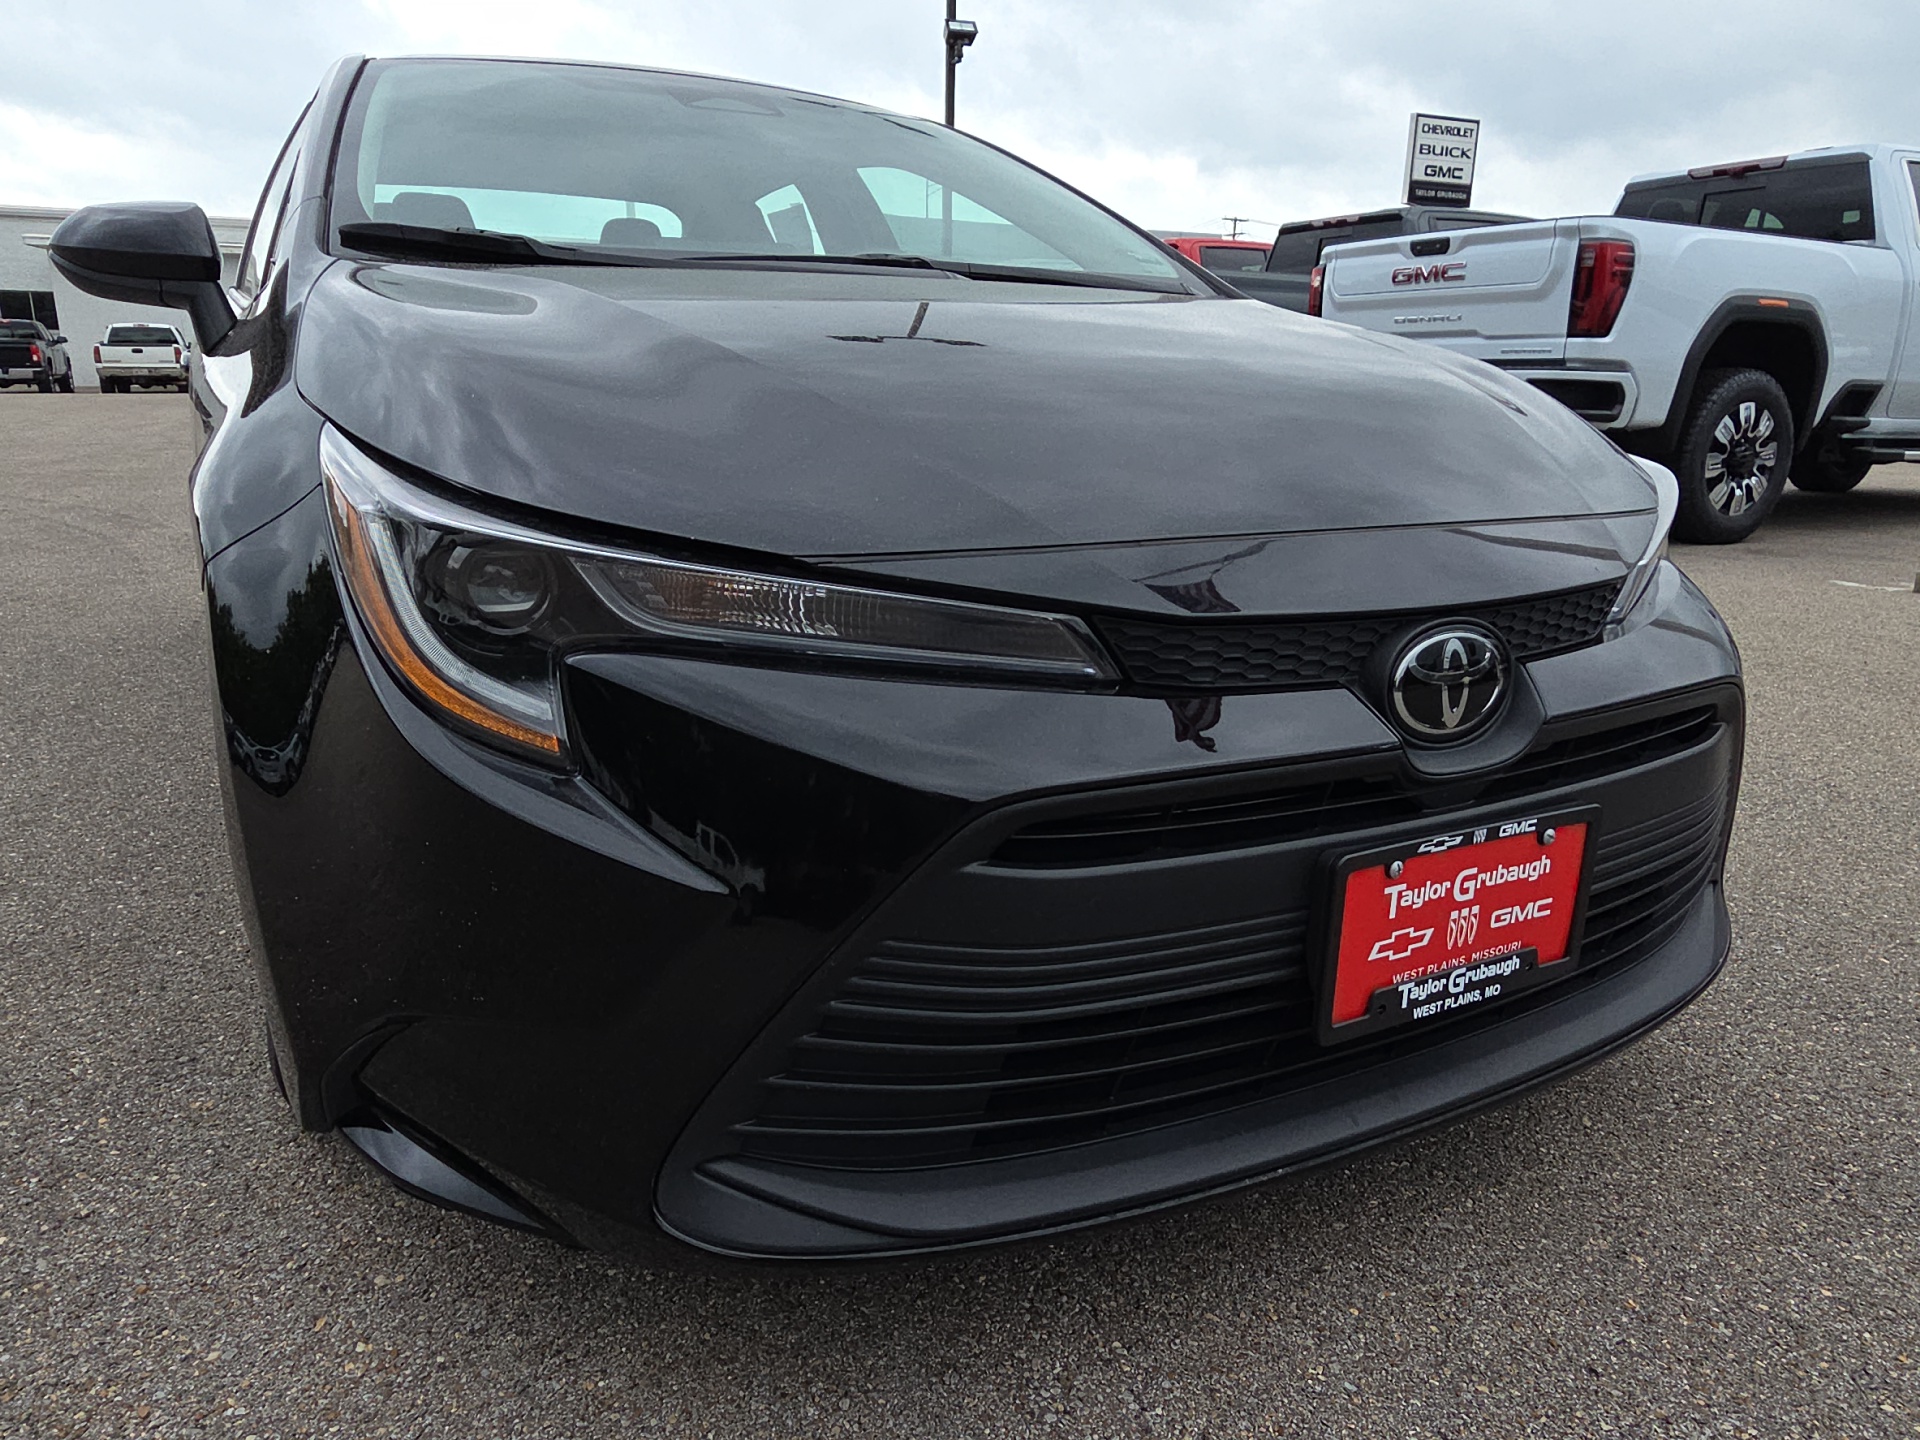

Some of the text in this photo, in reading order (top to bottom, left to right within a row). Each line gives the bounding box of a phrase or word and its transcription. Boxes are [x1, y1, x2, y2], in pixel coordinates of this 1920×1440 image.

[1421, 123, 1474, 138] CHEVROLET
[1419, 143, 1472, 160] BUICK
[1424, 164, 1464, 180] GMC
[1391, 260, 1467, 286] GMC
[1499, 818, 1538, 837] GMC
[1384, 854, 1551, 919] Taylor Grubaugh
[1490, 897, 1553, 929] GMC
[1392, 966, 1425, 984] WEST
[1470, 940, 1522, 962] MISSOURI
[1398, 955, 1520, 1009] Taylor Grubaugh
[1413, 984, 1501, 1020] WEST PLAINS, MO
